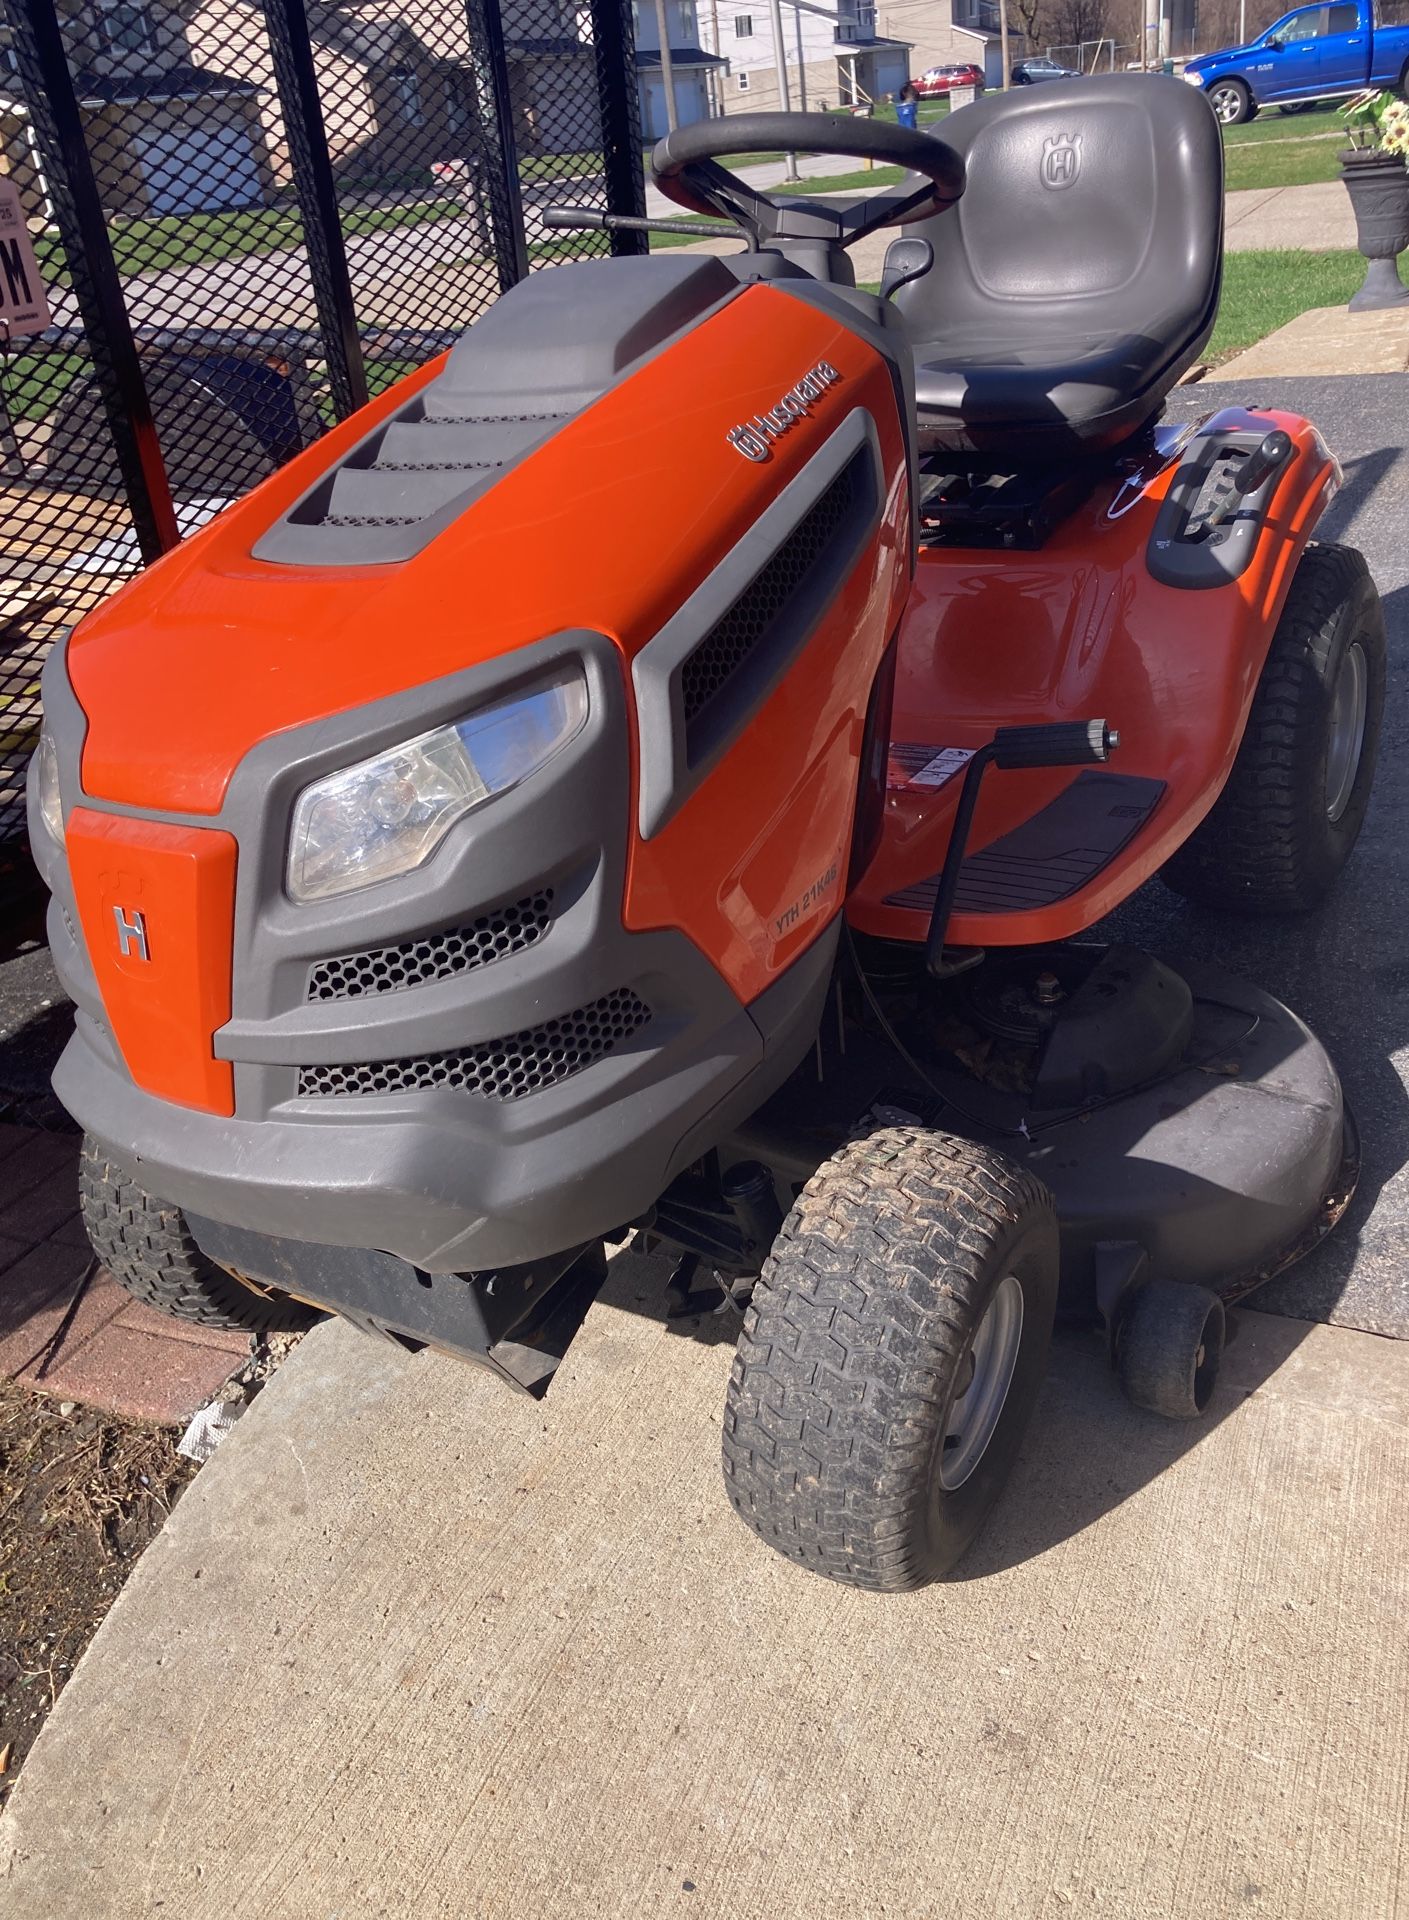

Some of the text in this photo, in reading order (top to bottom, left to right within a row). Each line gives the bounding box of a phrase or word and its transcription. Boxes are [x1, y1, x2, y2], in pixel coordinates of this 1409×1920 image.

[0, 237, 33, 308] M
[745, 360, 840, 445] Husqvarna
[112, 905, 149, 962] H
[776, 902, 799, 934] YTH
